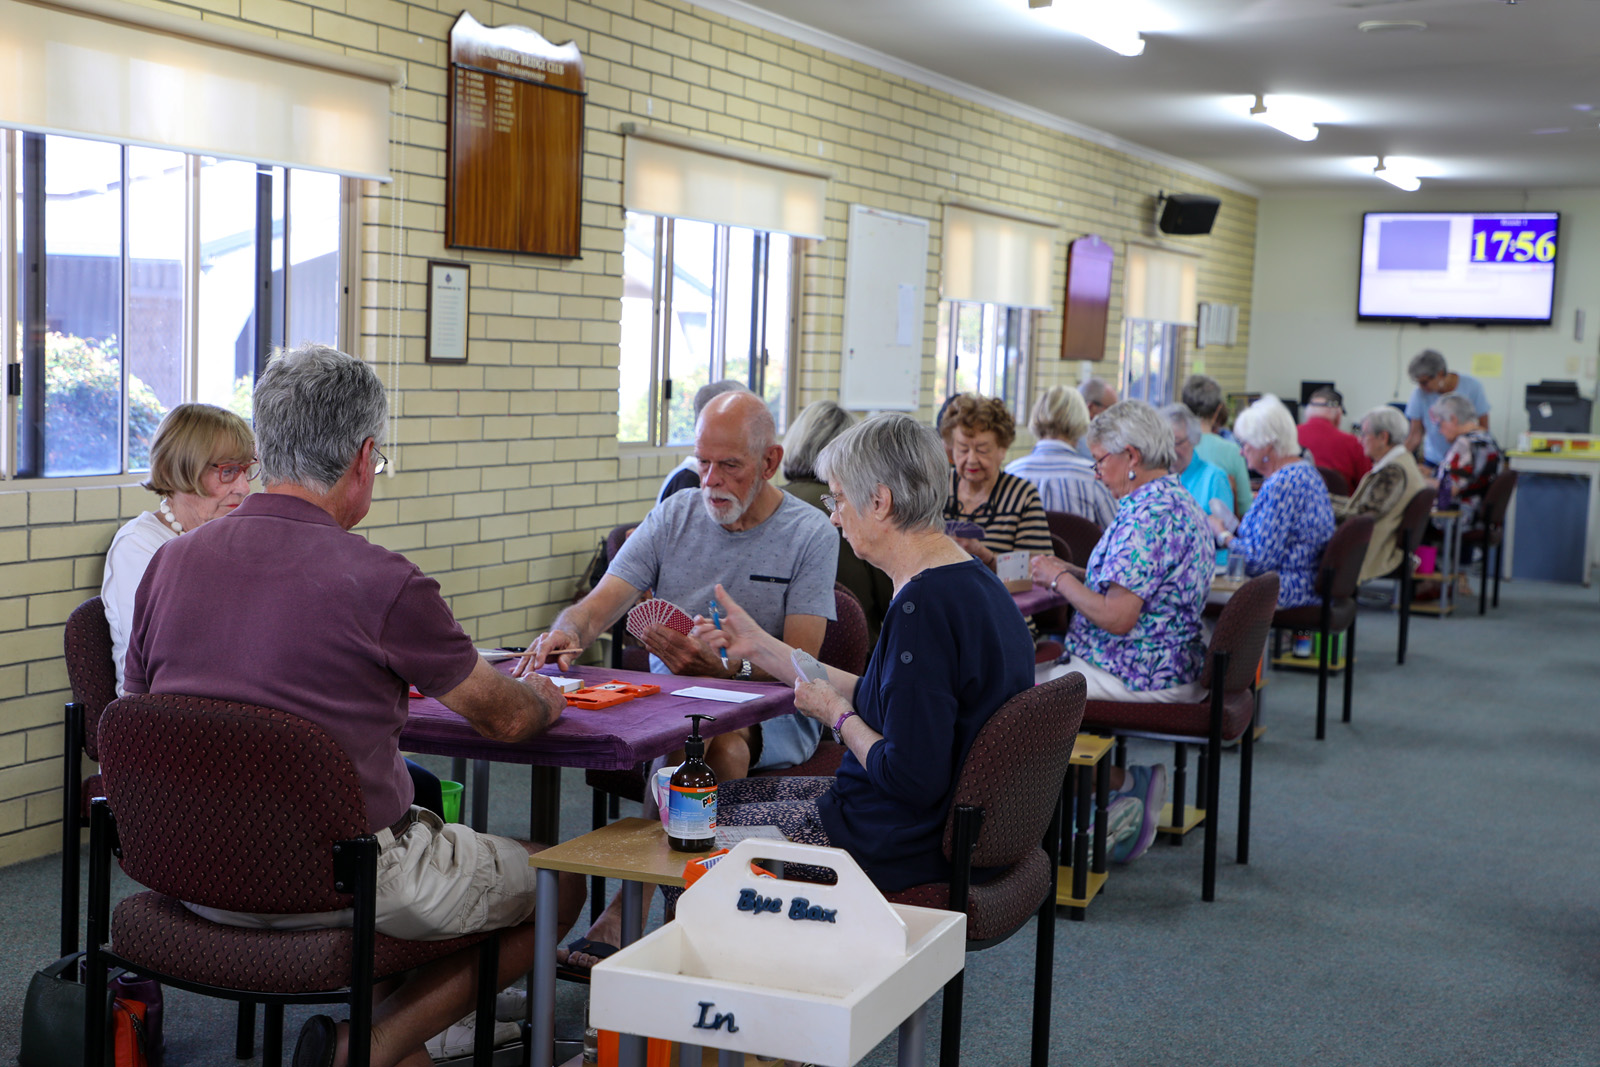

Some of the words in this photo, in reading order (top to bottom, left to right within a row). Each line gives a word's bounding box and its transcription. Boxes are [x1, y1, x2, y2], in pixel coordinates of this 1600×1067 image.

[547, 61, 565, 75] CLUB
[1473, 230, 1556, 262] 17:56
[737, 888, 783, 915] Bye
[788, 897, 838, 924] Box
[692, 1001, 739, 1033] In
